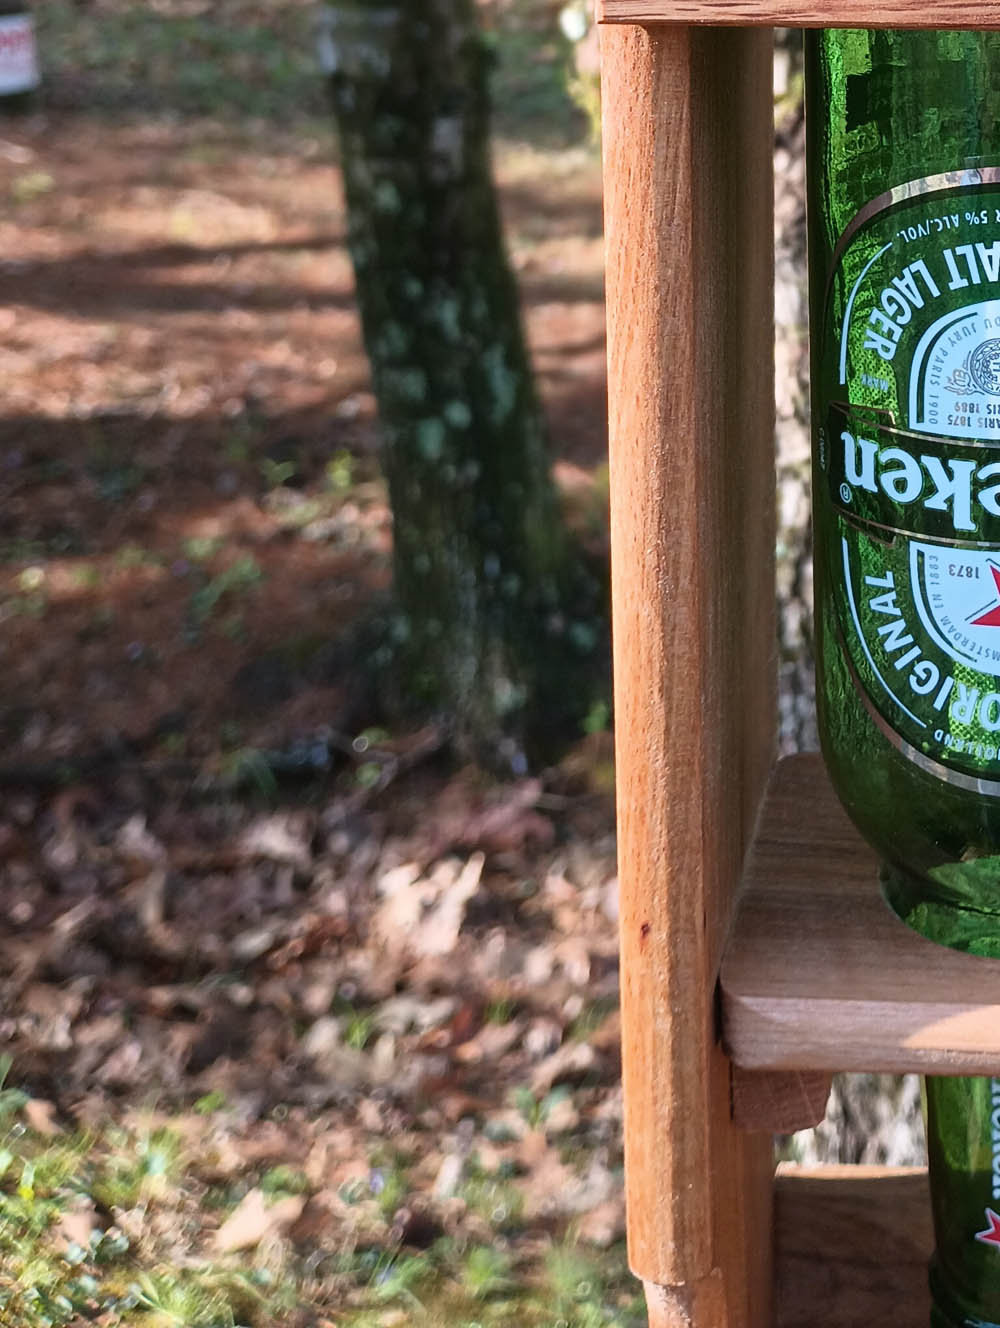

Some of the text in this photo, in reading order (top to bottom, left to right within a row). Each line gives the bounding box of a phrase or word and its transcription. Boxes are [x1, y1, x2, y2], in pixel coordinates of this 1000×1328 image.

[896, 214, 960, 243] ALC./VOL.
[964, 210, 988, 225] 5%
[863, 259, 941, 360] LAGER
[949, 322, 977, 346] JURY
[930, 344, 948, 386] PARIS
[928, 394, 939, 424] 1900
[954, 402, 980, 414] 1889
[947, 414, 972, 427] 1875
[929, 554, 940, 585] 1883
[948, 564, 980, 579] 1873
[932, 594, 944, 608] EN
